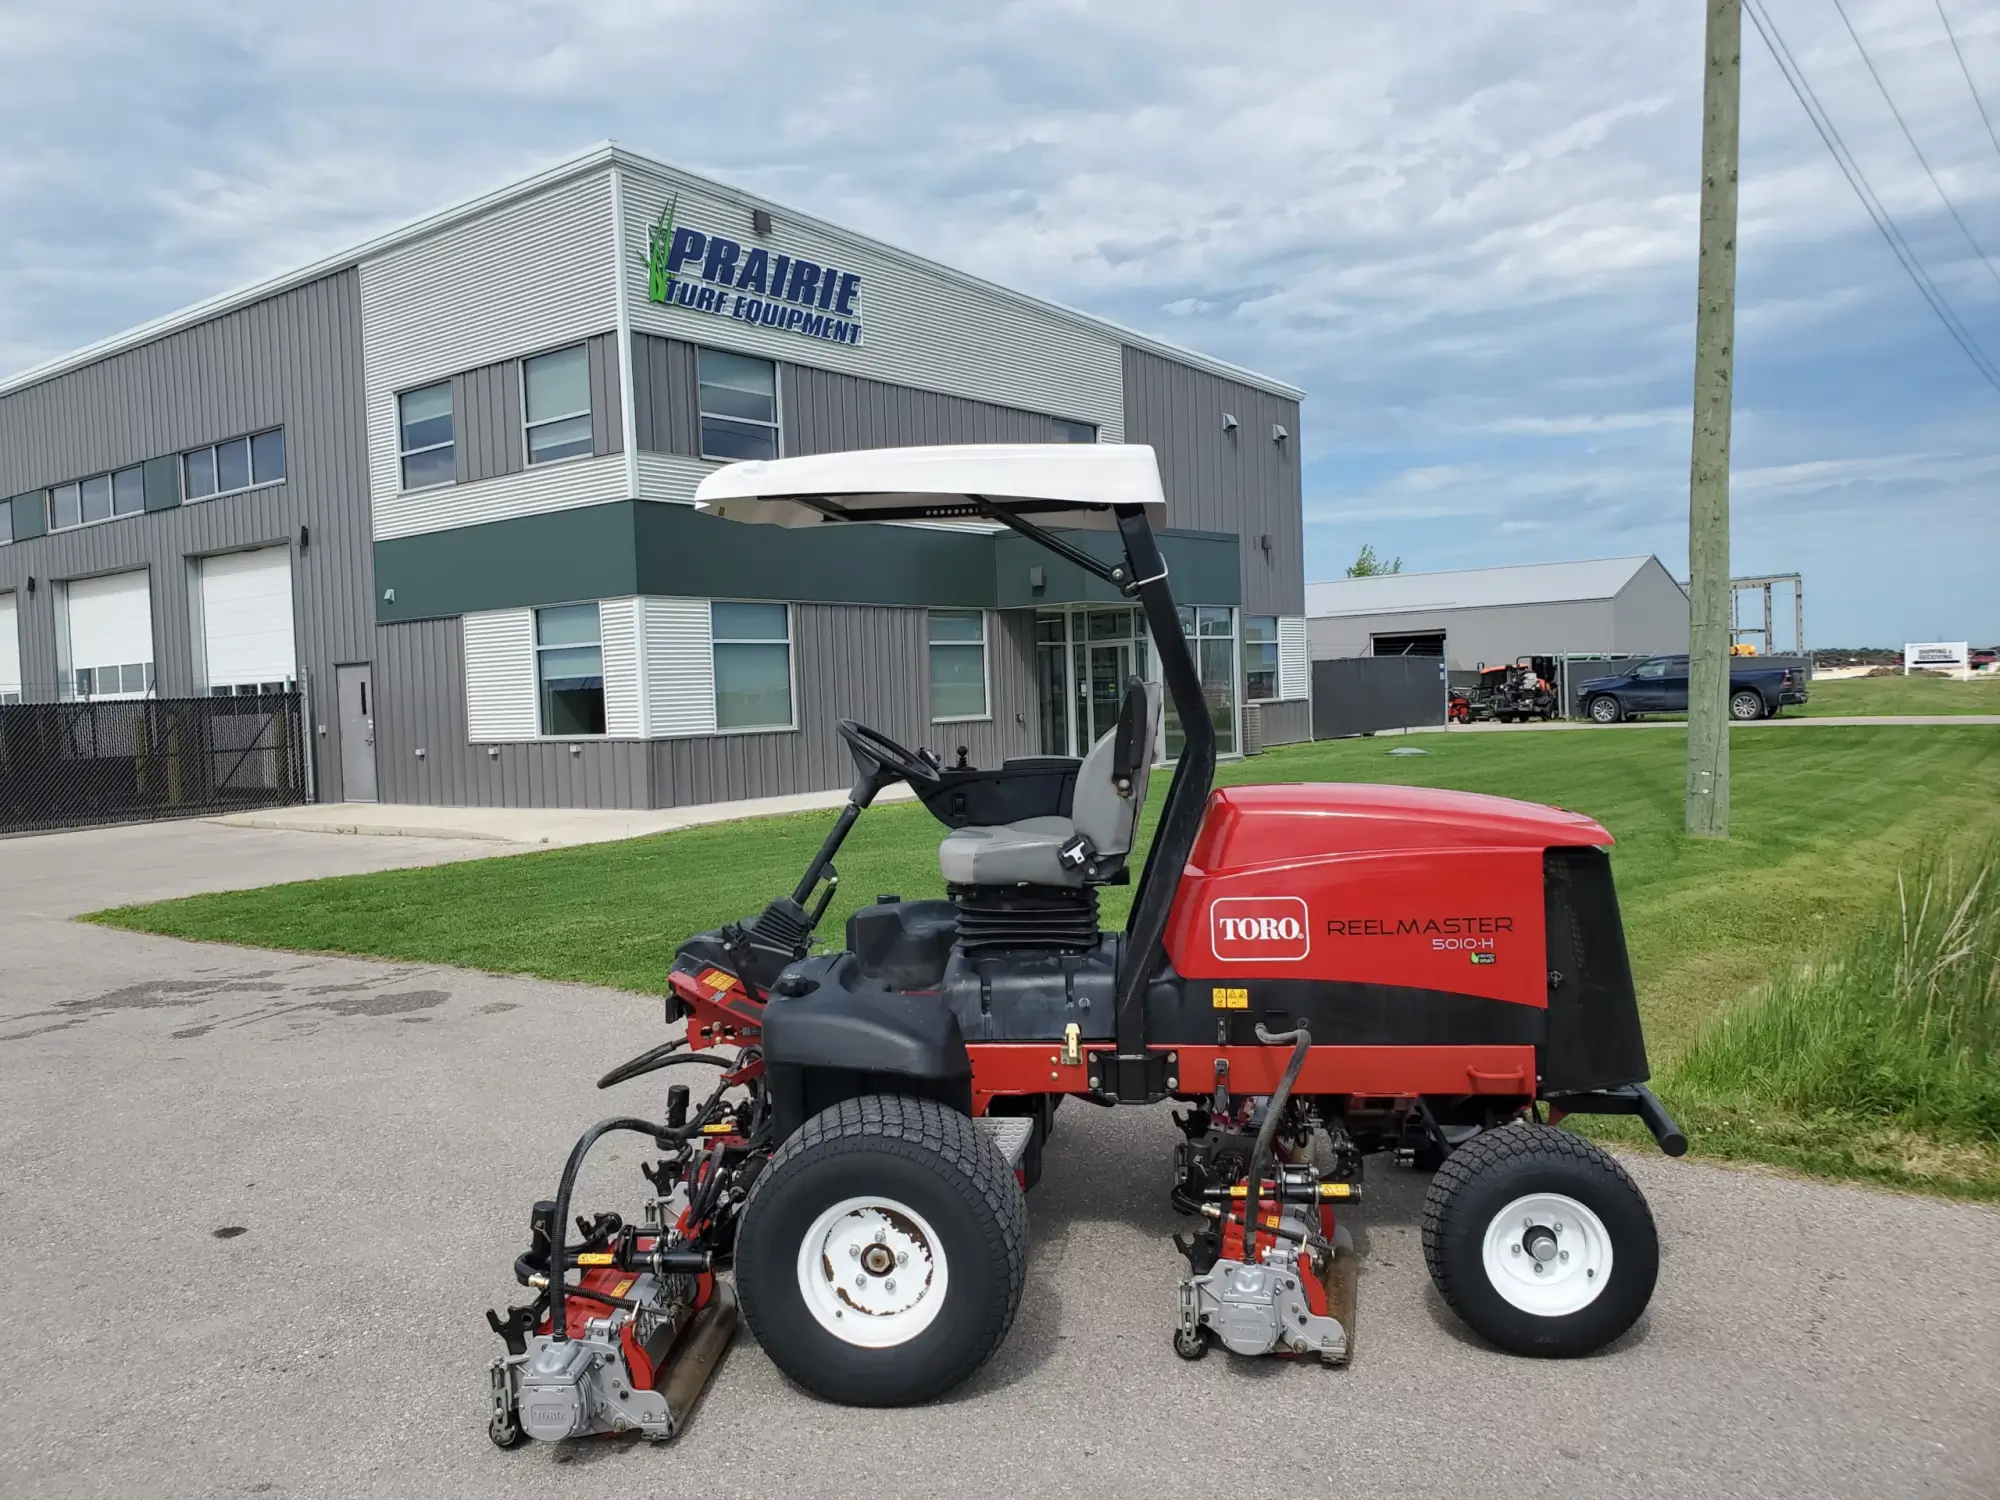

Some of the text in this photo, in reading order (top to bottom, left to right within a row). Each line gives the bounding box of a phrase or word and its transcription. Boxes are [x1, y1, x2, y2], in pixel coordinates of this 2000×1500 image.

[666, 226, 862, 316] PRAIRIE
[666, 279, 862, 345] TURF EQUIPMENT
[1219, 917, 1300, 941] TORO
[1327, 917, 1513, 936] REELMASTER
